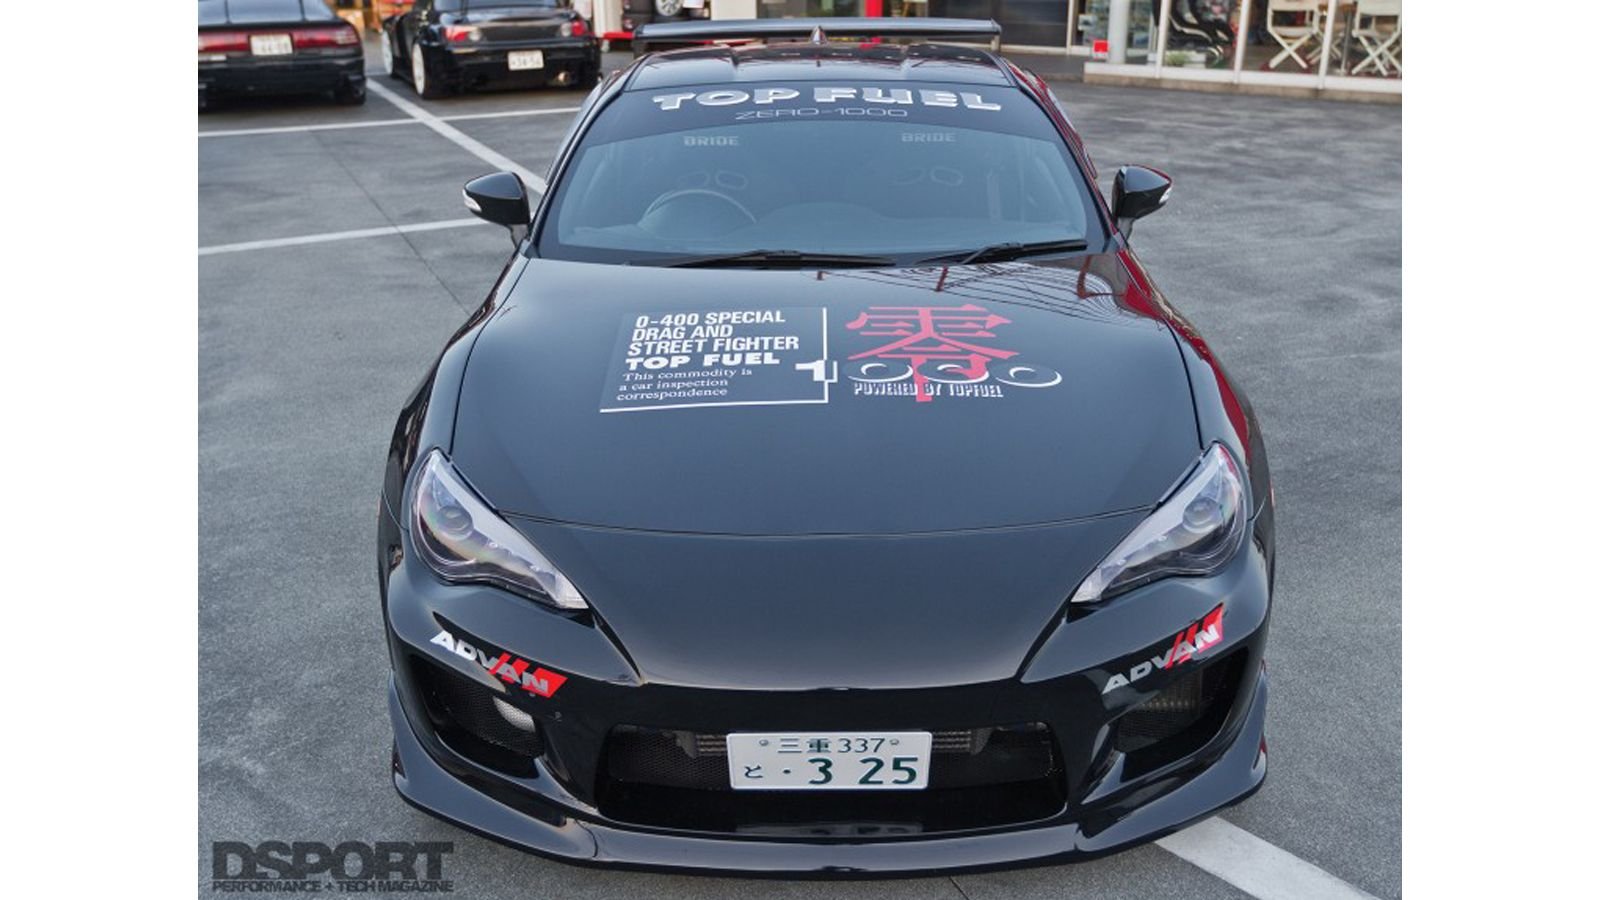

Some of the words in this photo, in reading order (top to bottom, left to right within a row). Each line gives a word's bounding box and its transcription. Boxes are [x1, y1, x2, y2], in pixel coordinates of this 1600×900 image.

[653, 87, 800, 111] TOP
[813, 87, 1002, 111] FUEL
[735, 107, 908, 120] ZERO-1000
[683, 135, 740, 147] BRIDE
[901, 132, 957, 143] BRIDE
[635, 313, 699, 329] 0-400
[704, 310, 786, 325] SPECIAL
[632, 326, 687, 342] DRAG
[690, 325, 733, 339] AND
[627, 338, 708, 357] STREET
[713, 336, 800, 352] FIGHTER
[625, 355, 692, 371] TOP
[703, 352, 780, 367] FUEL
[623, 372, 654, 382] This
[658, 368, 737, 380] commodity
[741, 367, 753, 376] is
[631, 382, 654, 391] car
[657, 378, 729, 392] inspection
[854, 382, 919, 396] POWERED
[923, 383, 942, 396] BY
[616, 388, 728, 401] correspondence
[430, 629, 549, 694] ADVAN
[1102, 623, 1220, 695] ADVAN
